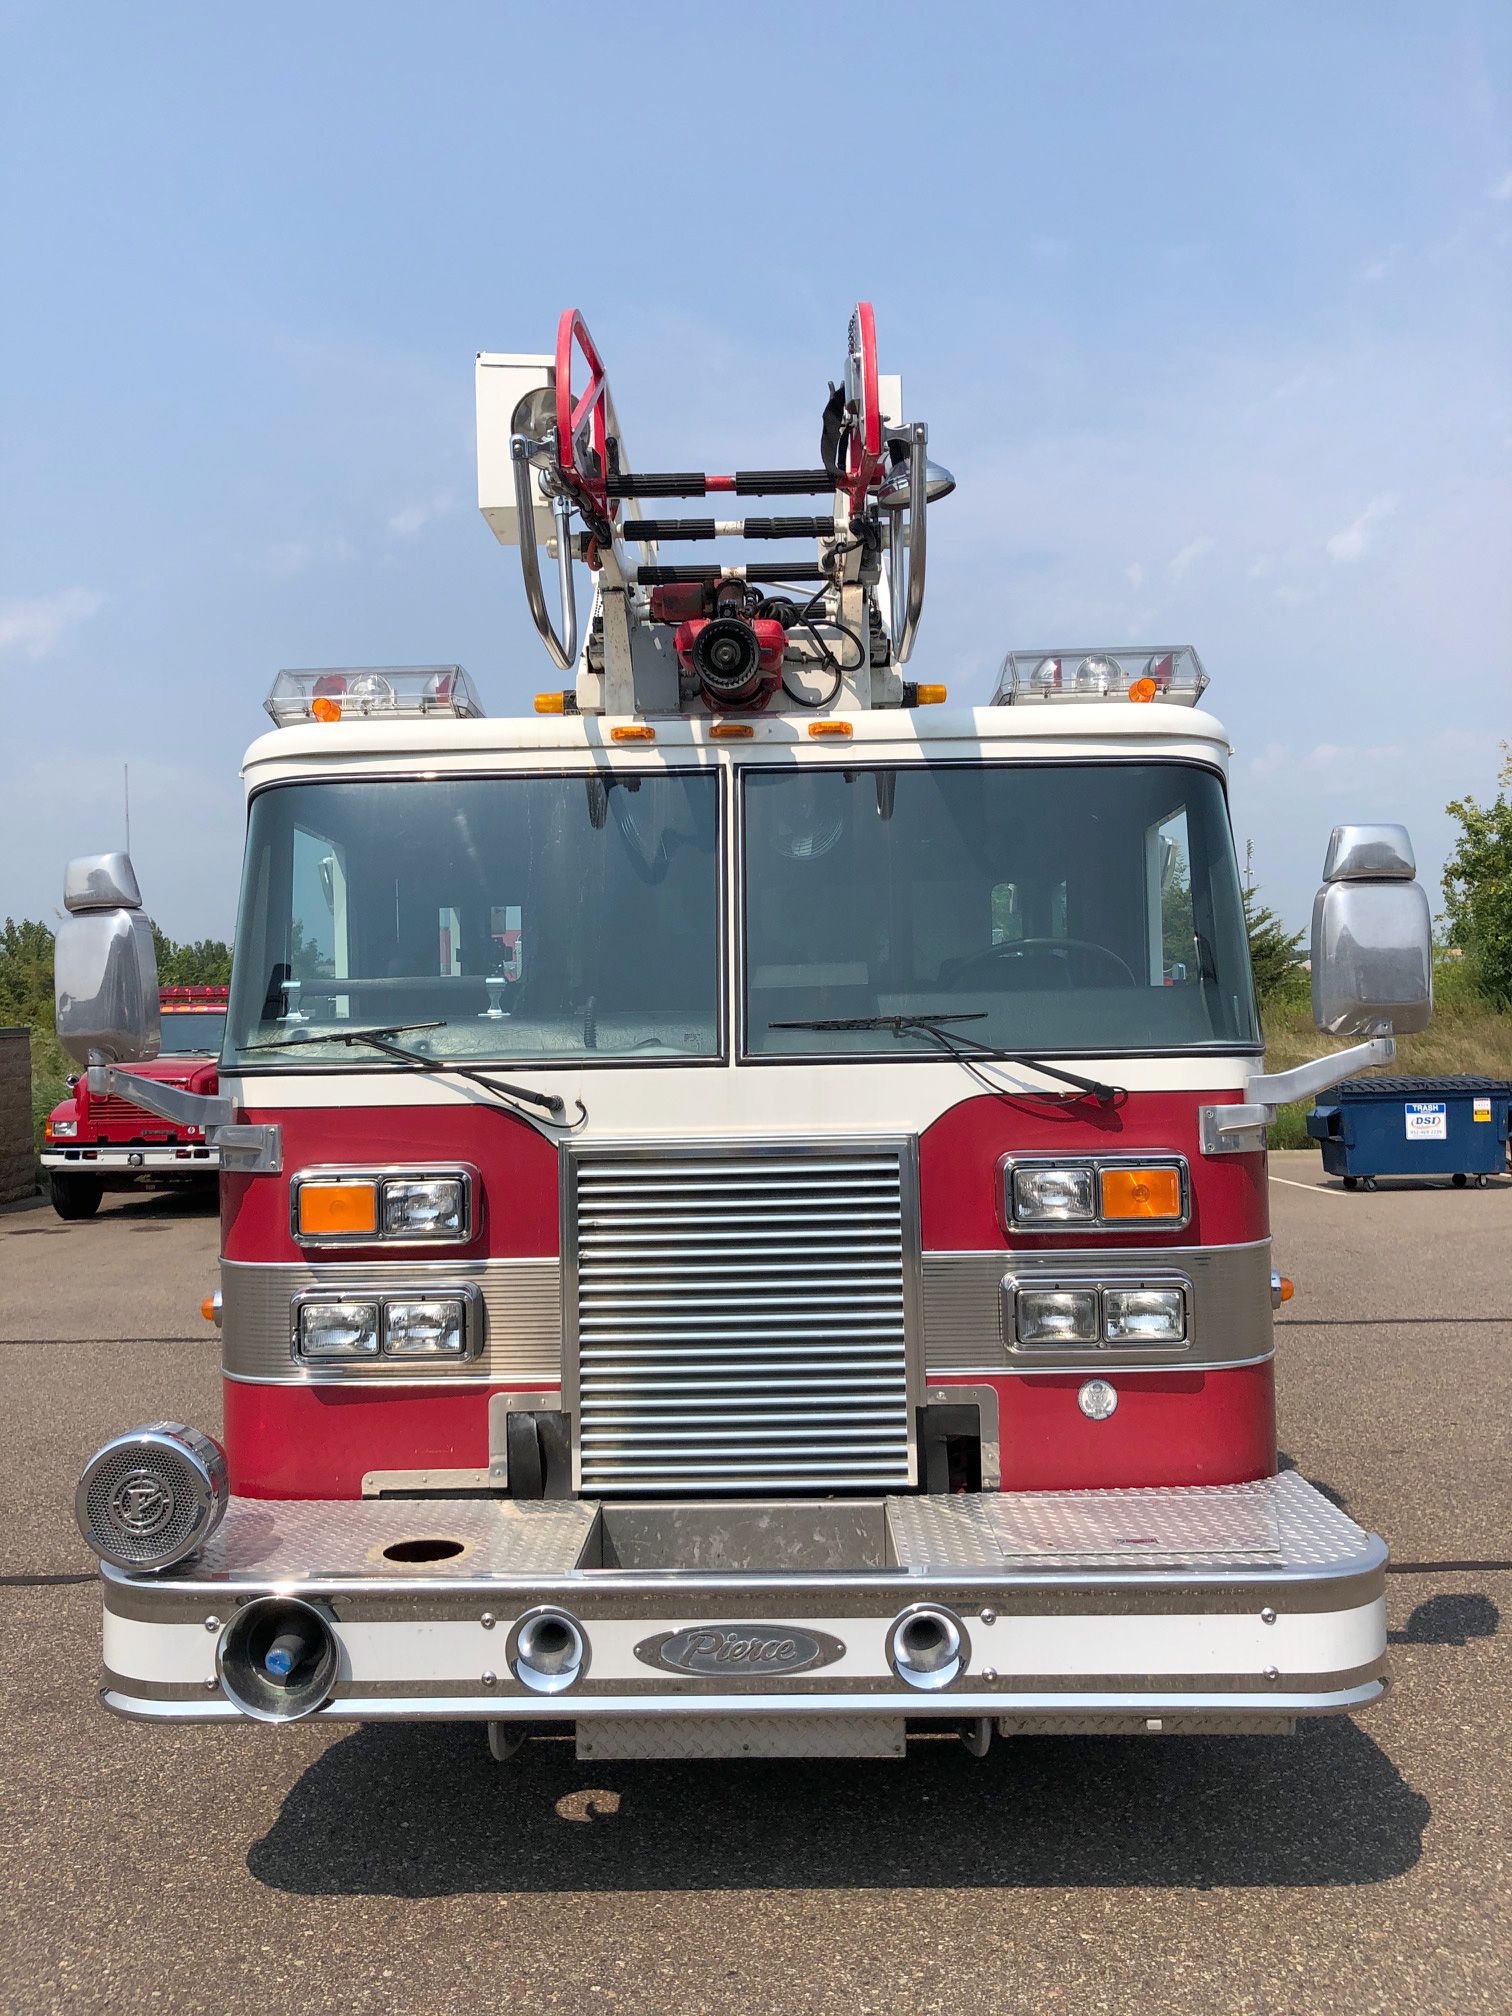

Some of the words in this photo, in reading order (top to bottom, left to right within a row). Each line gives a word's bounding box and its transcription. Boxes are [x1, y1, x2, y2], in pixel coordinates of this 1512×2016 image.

[1412, 1104, 1439, 1112] TRASH
[1416, 1117, 1436, 1125] DSI
[680, 1631, 797, 1667] Pierce
